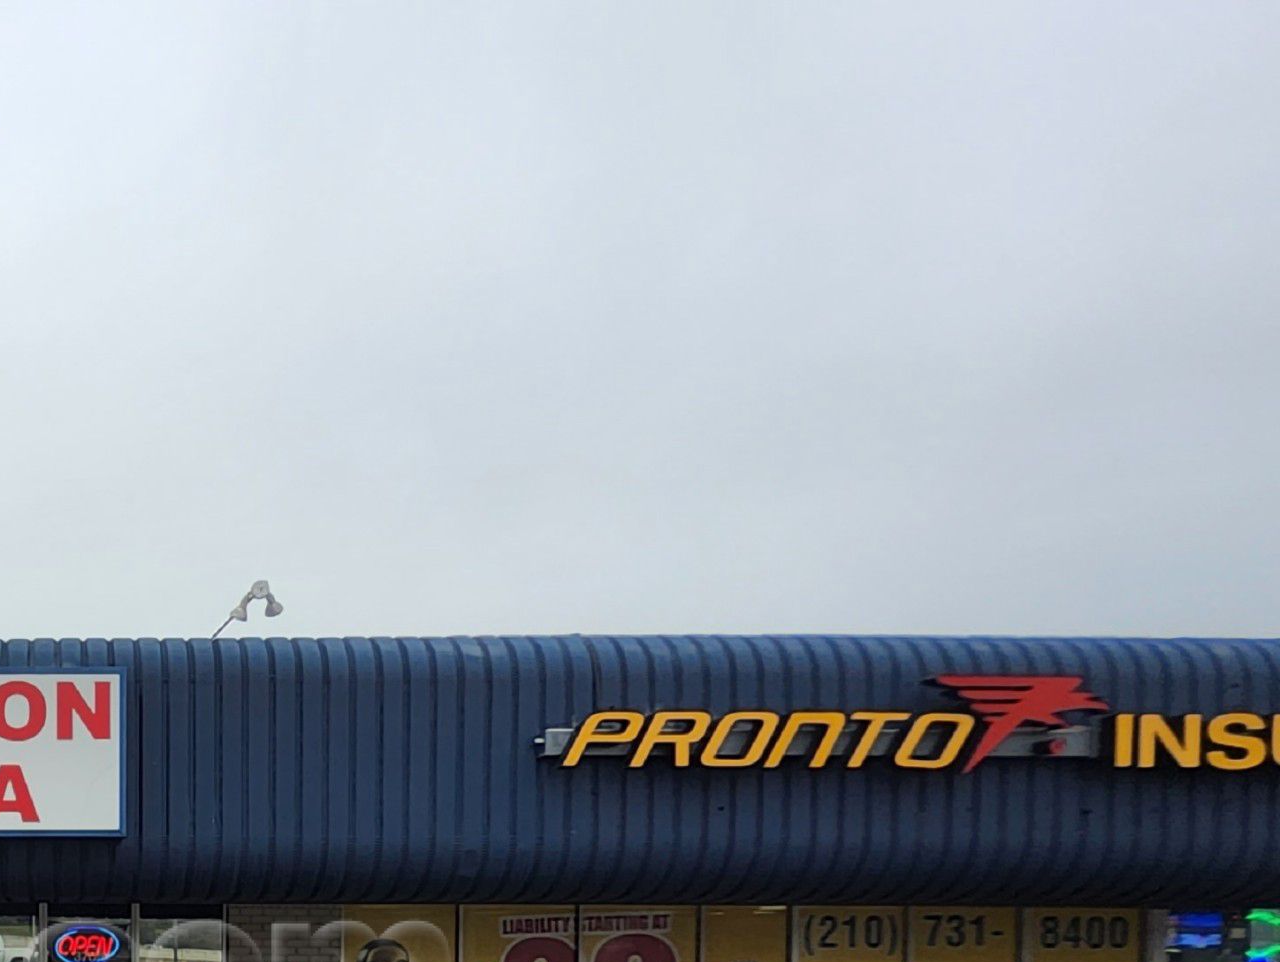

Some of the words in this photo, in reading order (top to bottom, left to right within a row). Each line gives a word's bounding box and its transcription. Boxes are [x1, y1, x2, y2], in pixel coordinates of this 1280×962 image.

[561, 710, 976, 769] PRONTO
[1114, 713, 1280, 770] INS
[502, 916, 570, 935] LIABILITY
[803, 914, 899, 956] (210)
[57, 935, 114, 958] OPEN
